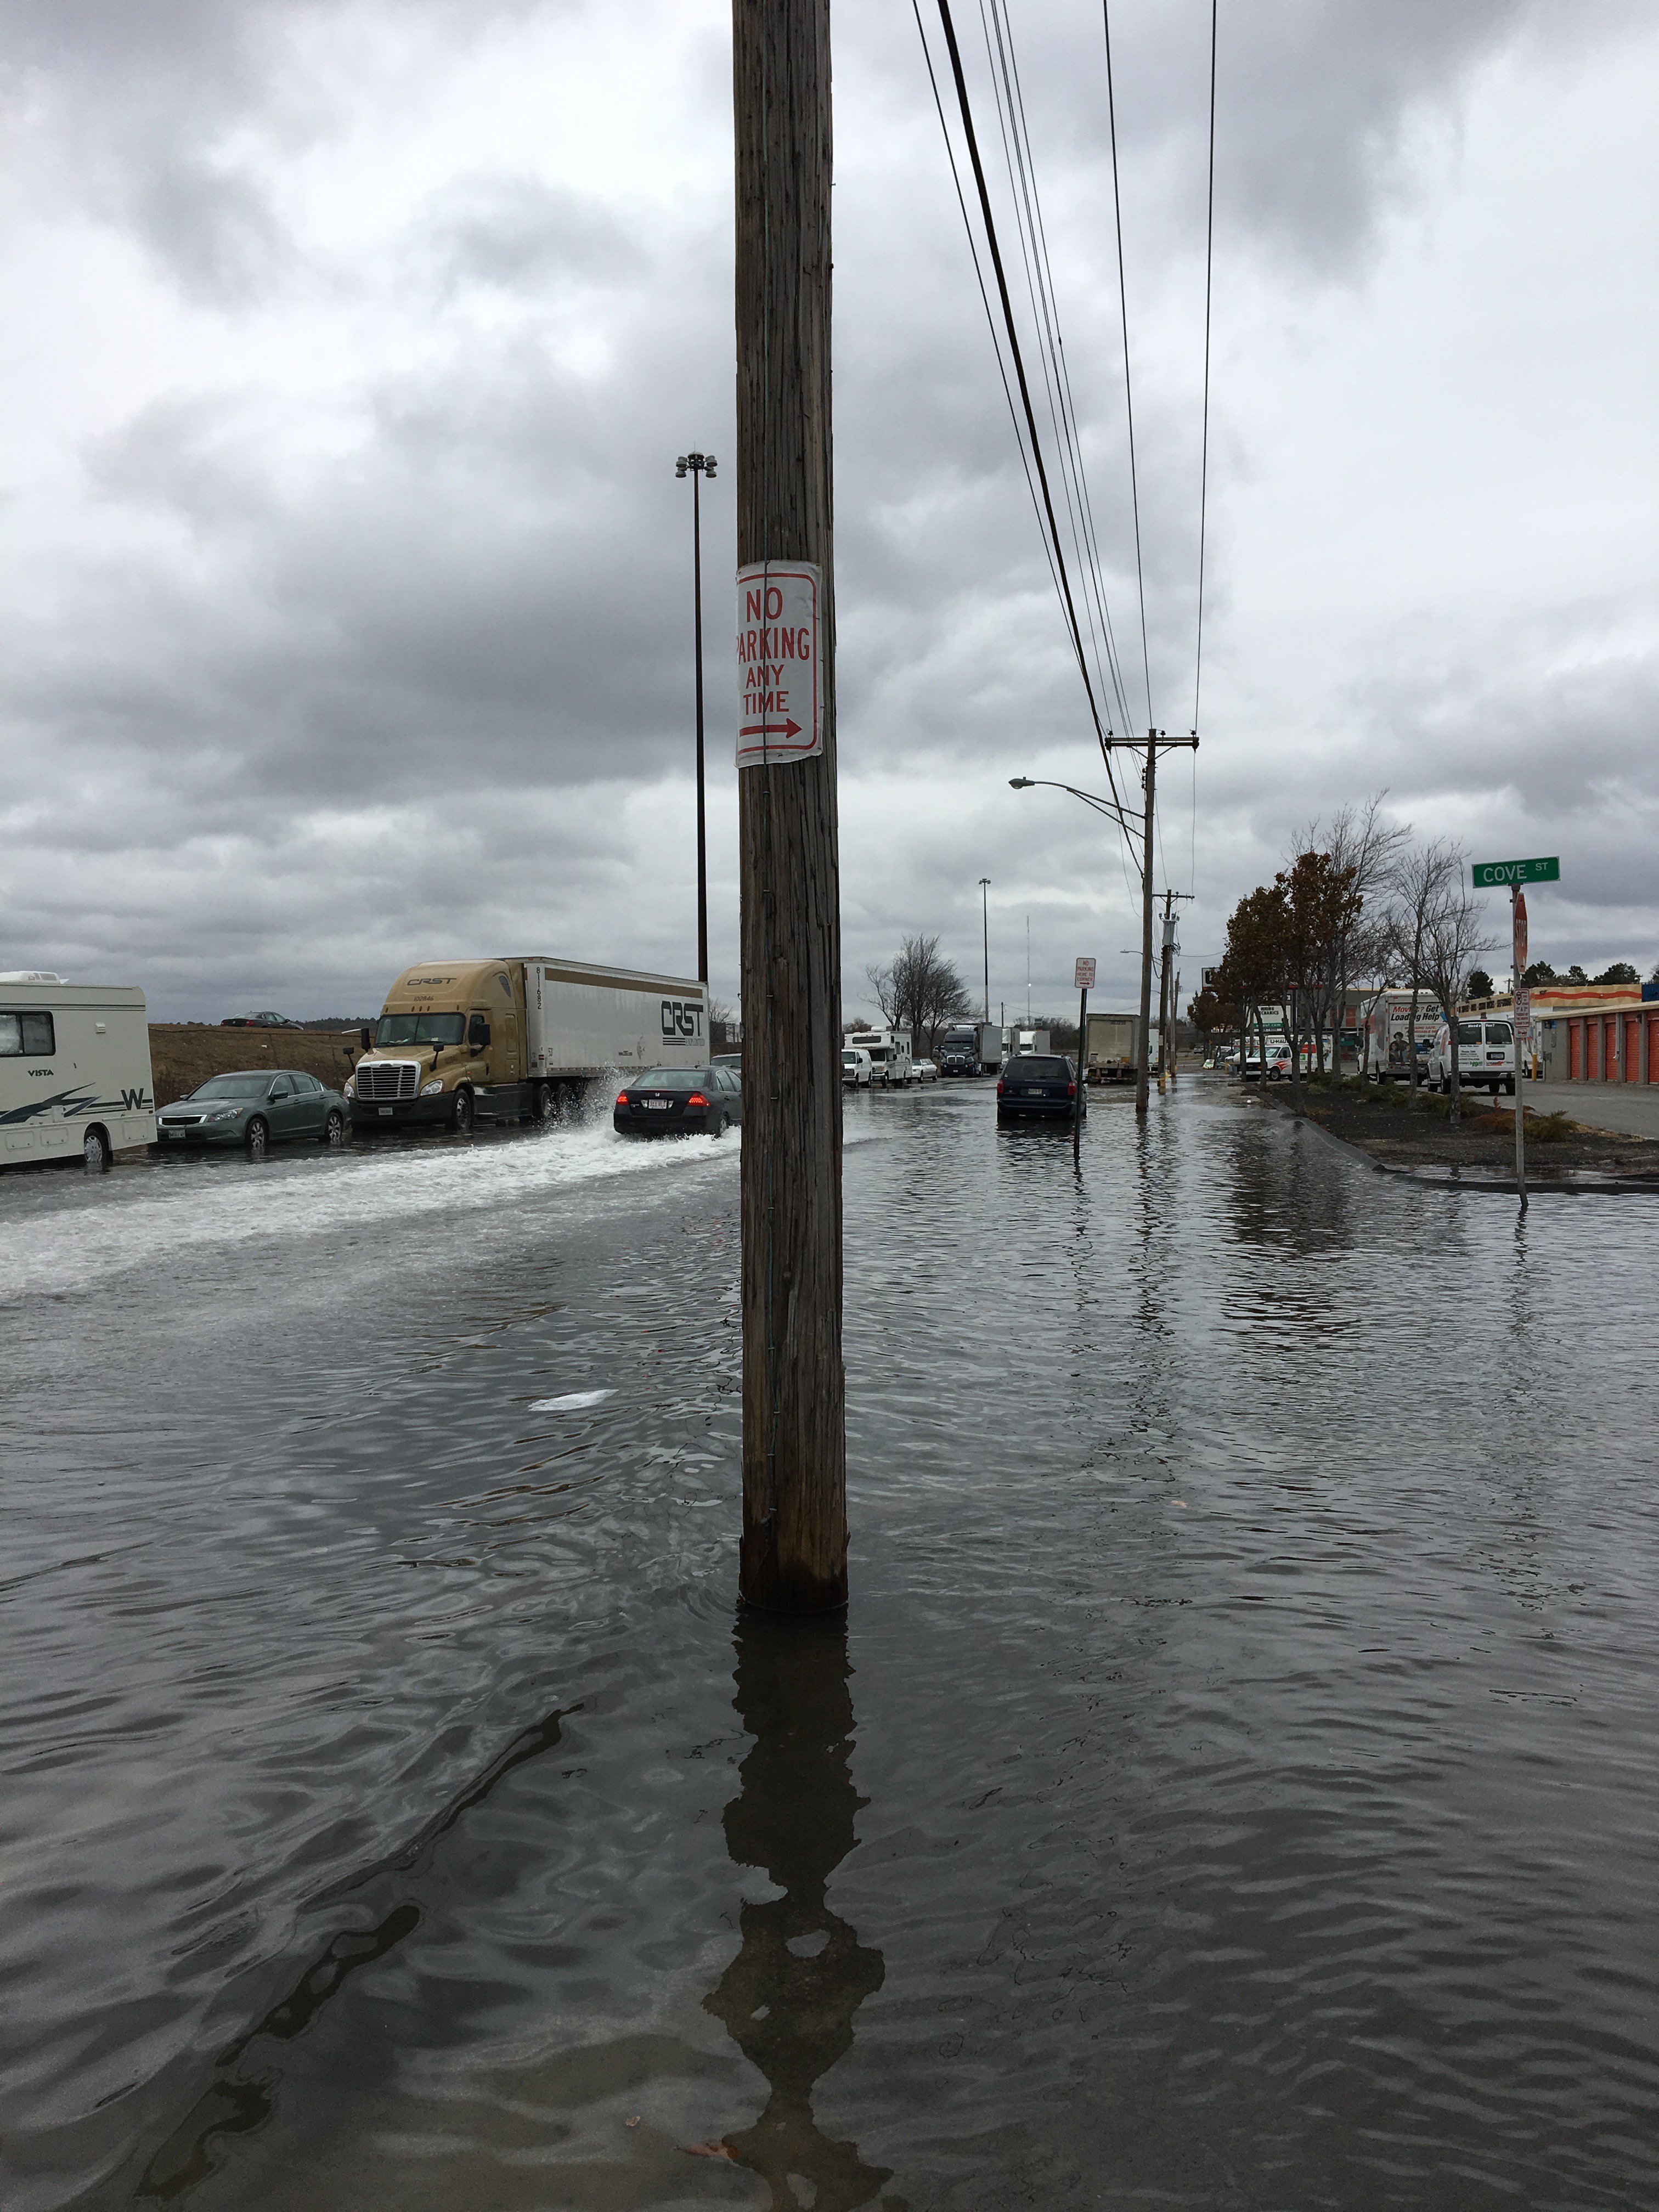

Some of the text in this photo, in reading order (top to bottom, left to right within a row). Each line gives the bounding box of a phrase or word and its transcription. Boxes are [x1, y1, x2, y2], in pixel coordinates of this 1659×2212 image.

[747, 587, 782, 623] NO
[746, 664, 784, 689] ANY
[743, 691, 789, 715] TIME
[1483, 862, 1548, 882] COVE ST
[661, 1001, 704, 1036] CRST
[1391, 1013, 1440, 1022] Loadg Help
[121, 1088, 144, 1110] W
